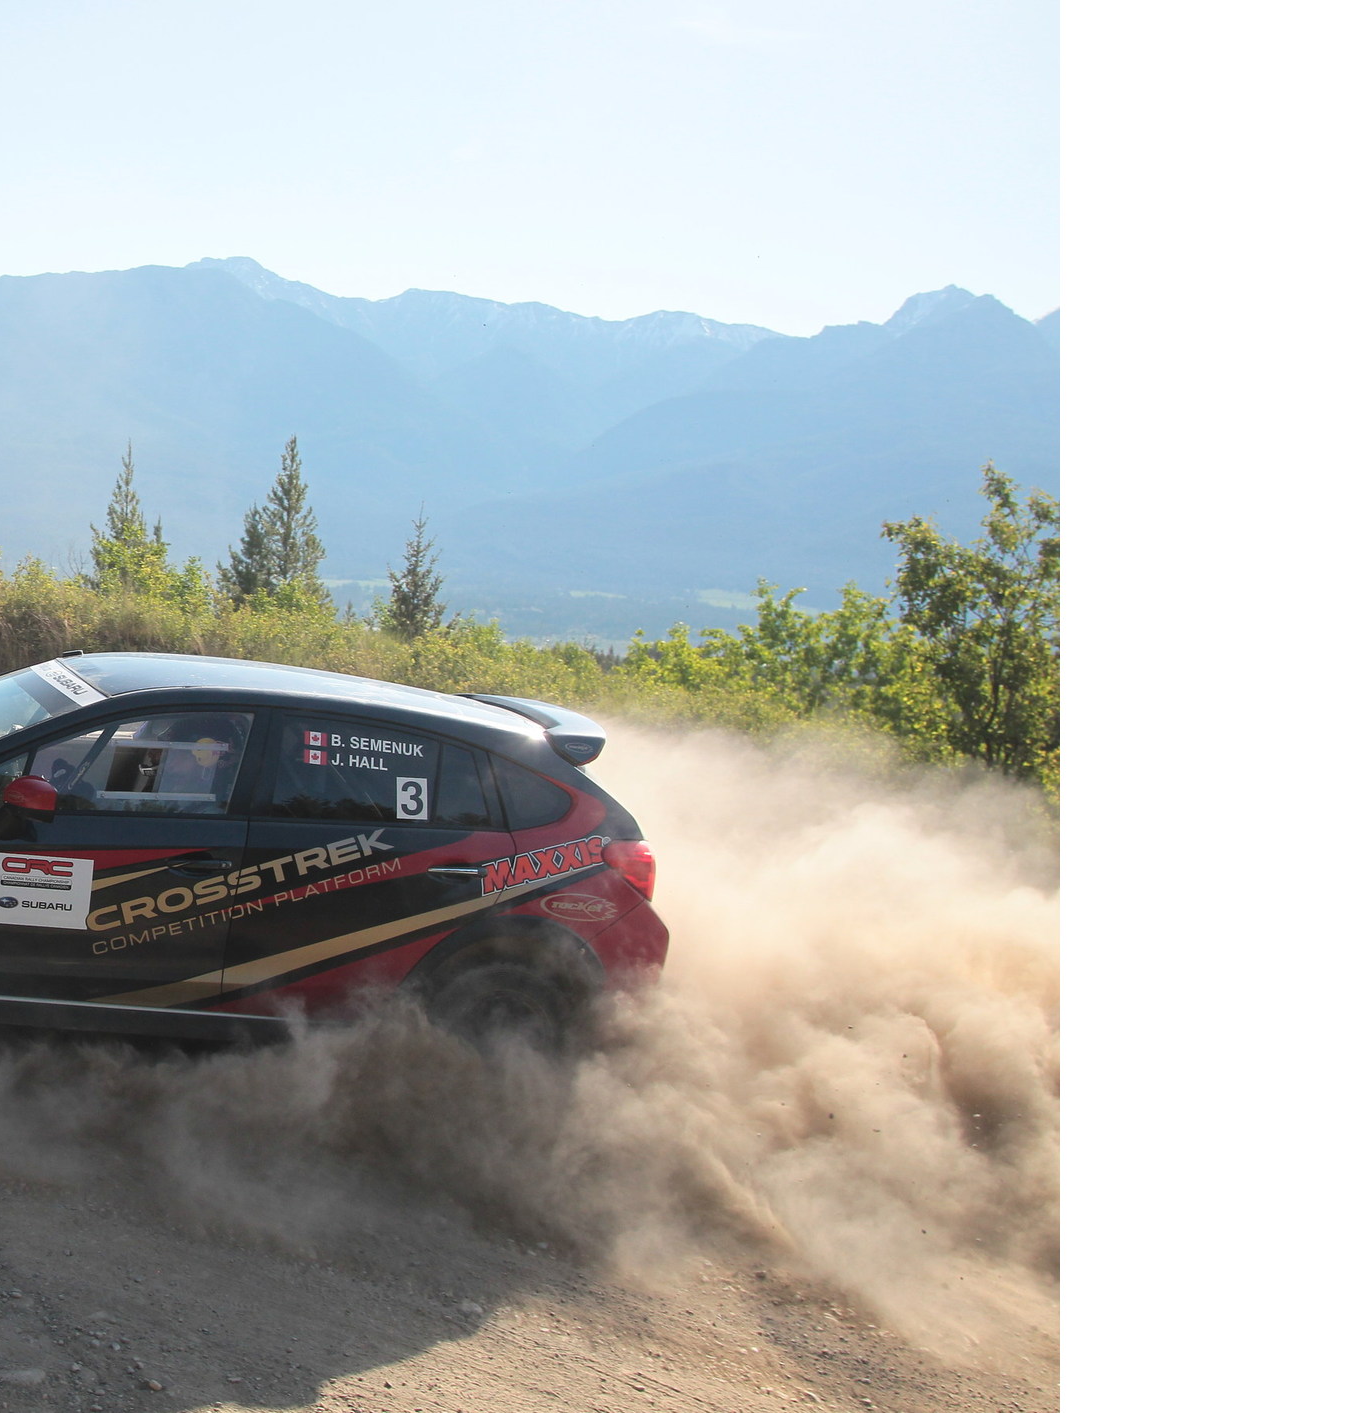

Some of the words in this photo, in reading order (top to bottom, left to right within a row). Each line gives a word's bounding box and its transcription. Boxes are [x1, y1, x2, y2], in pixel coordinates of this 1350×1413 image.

[53, 674, 89, 696] SUBARU
[331, 733, 345, 747] B.
[350, 736, 424, 757] SEMENUK
[331, 753, 344, 766] J.
[349, 755, 388, 771] HALL
[400, 780, 424, 816] 3
[2, 856, 74, 877] CRC
[482, 835, 605, 896] MAXXIS
[86, 828, 394, 931] CROSSTREK
[21, 900, 72, 911] SUBARU
[92, 899, 264, 955] COMPETITION
[273, 858, 402, 907] PLATFORM
